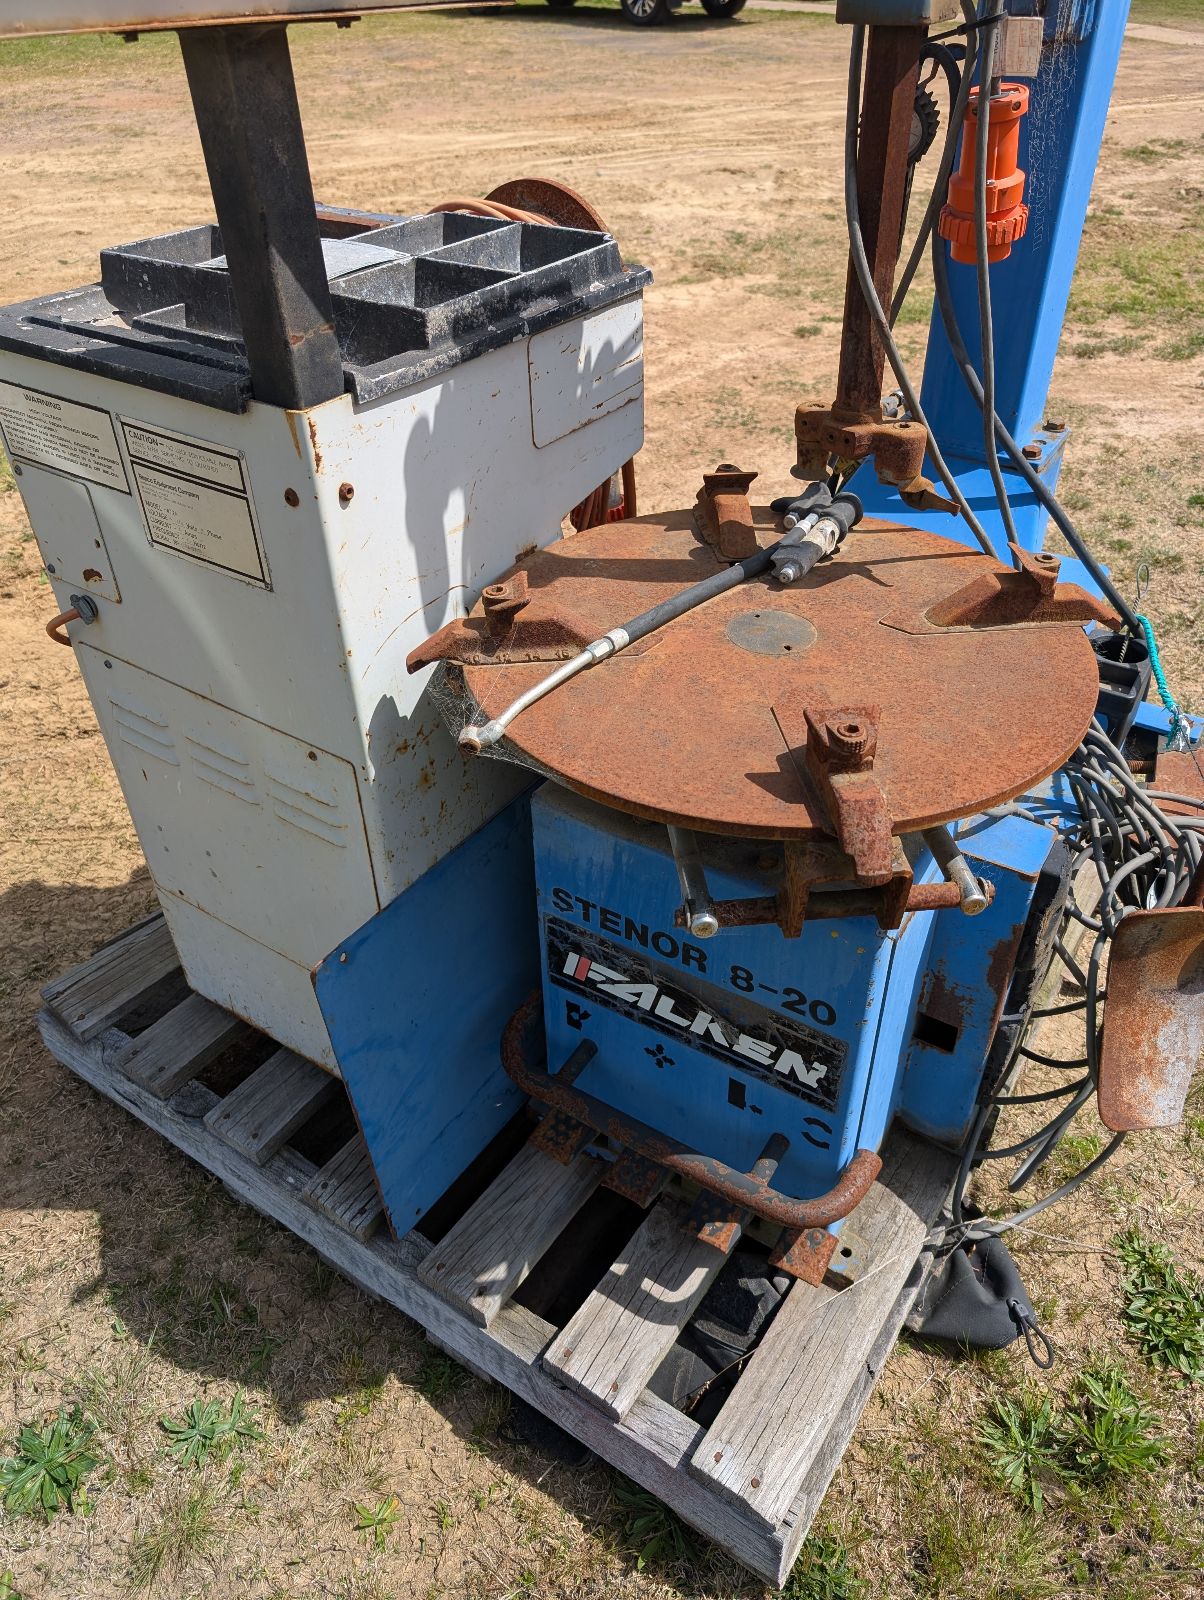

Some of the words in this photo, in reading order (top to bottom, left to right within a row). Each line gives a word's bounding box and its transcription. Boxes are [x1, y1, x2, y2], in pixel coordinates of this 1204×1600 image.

[24, 394, 61, 410] WARNING
[551, 887, 708, 974] STENOR
[729, 965, 837, 1026] 8-20
[562, 951, 829, 1089] FALKEN
